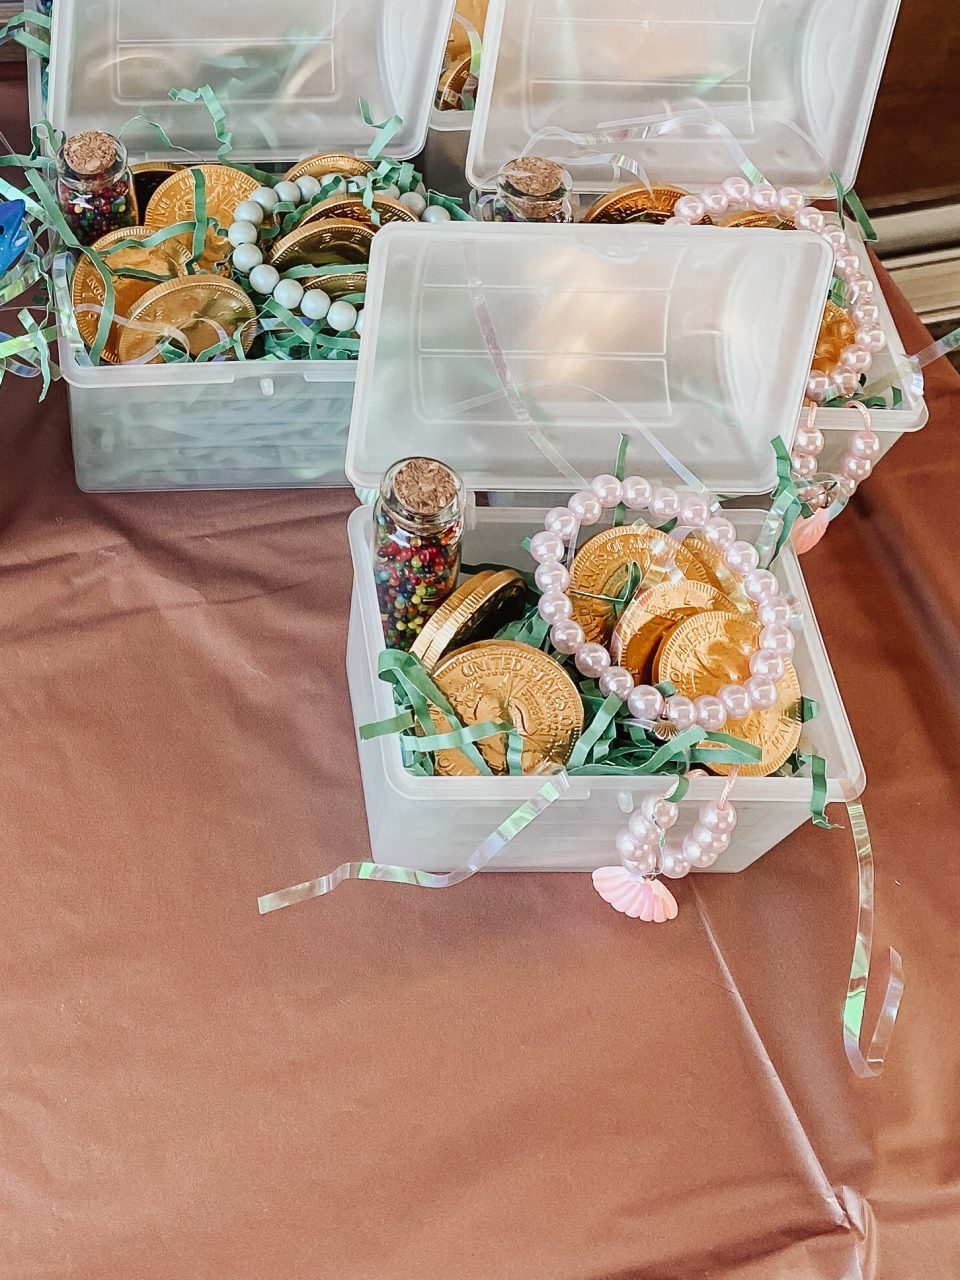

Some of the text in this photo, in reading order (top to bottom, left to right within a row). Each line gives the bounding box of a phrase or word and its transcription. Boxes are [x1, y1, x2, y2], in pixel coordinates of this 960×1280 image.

[676, 620, 728, 658] AMERICA
[460, 655, 525, 678] UNITED
[530, 665, 572, 712] STATES
